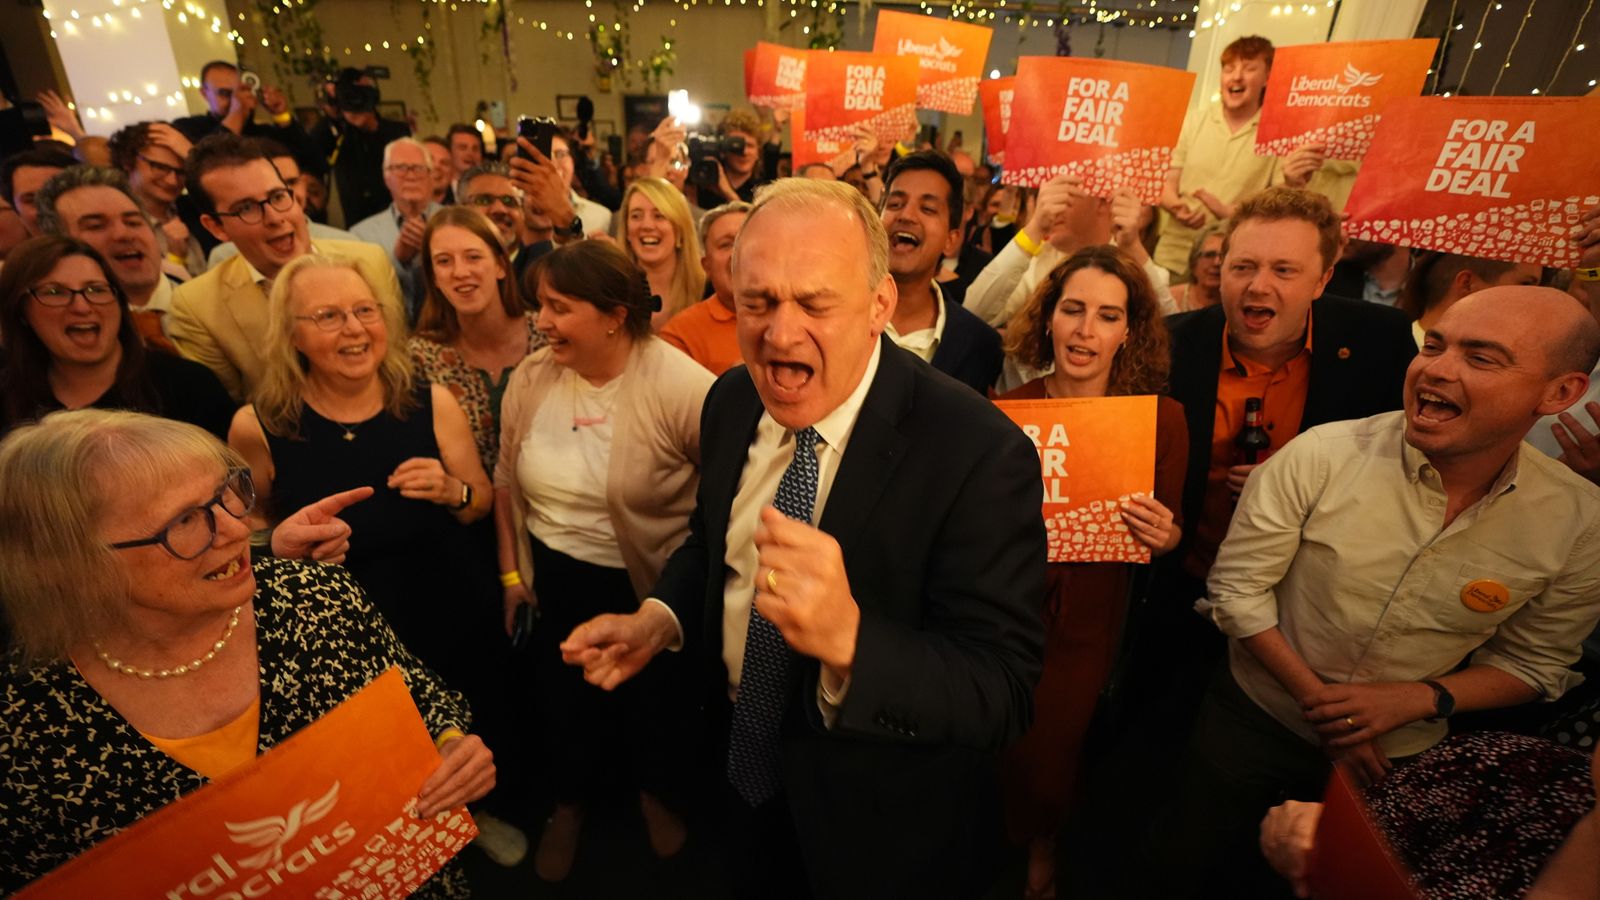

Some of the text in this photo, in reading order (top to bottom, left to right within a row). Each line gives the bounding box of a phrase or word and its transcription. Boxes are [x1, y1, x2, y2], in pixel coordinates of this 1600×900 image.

[896, 38, 937, 57] Liberal
[846, 65, 886, 80] FOR A
[919, 57, 957, 73] ocrats
[845, 79, 884, 97] FAIR
[1068, 77, 1130, 101] FOR A
[1290, 73, 1339, 91] Liberal
[844, 95, 883, 110] DEAL
[1063, 97, 1125, 126] FAIR
[1286, 92, 1372, 108] Democrats
[1058, 120, 1119, 148] DEAL
[1446, 119, 1536, 143] FOR A
[1435, 141, 1526, 173] FAIR
[1424, 168, 1511, 199] DEAL
[1046, 423, 1070, 447] A
[214, 820, 356, 900] crats
